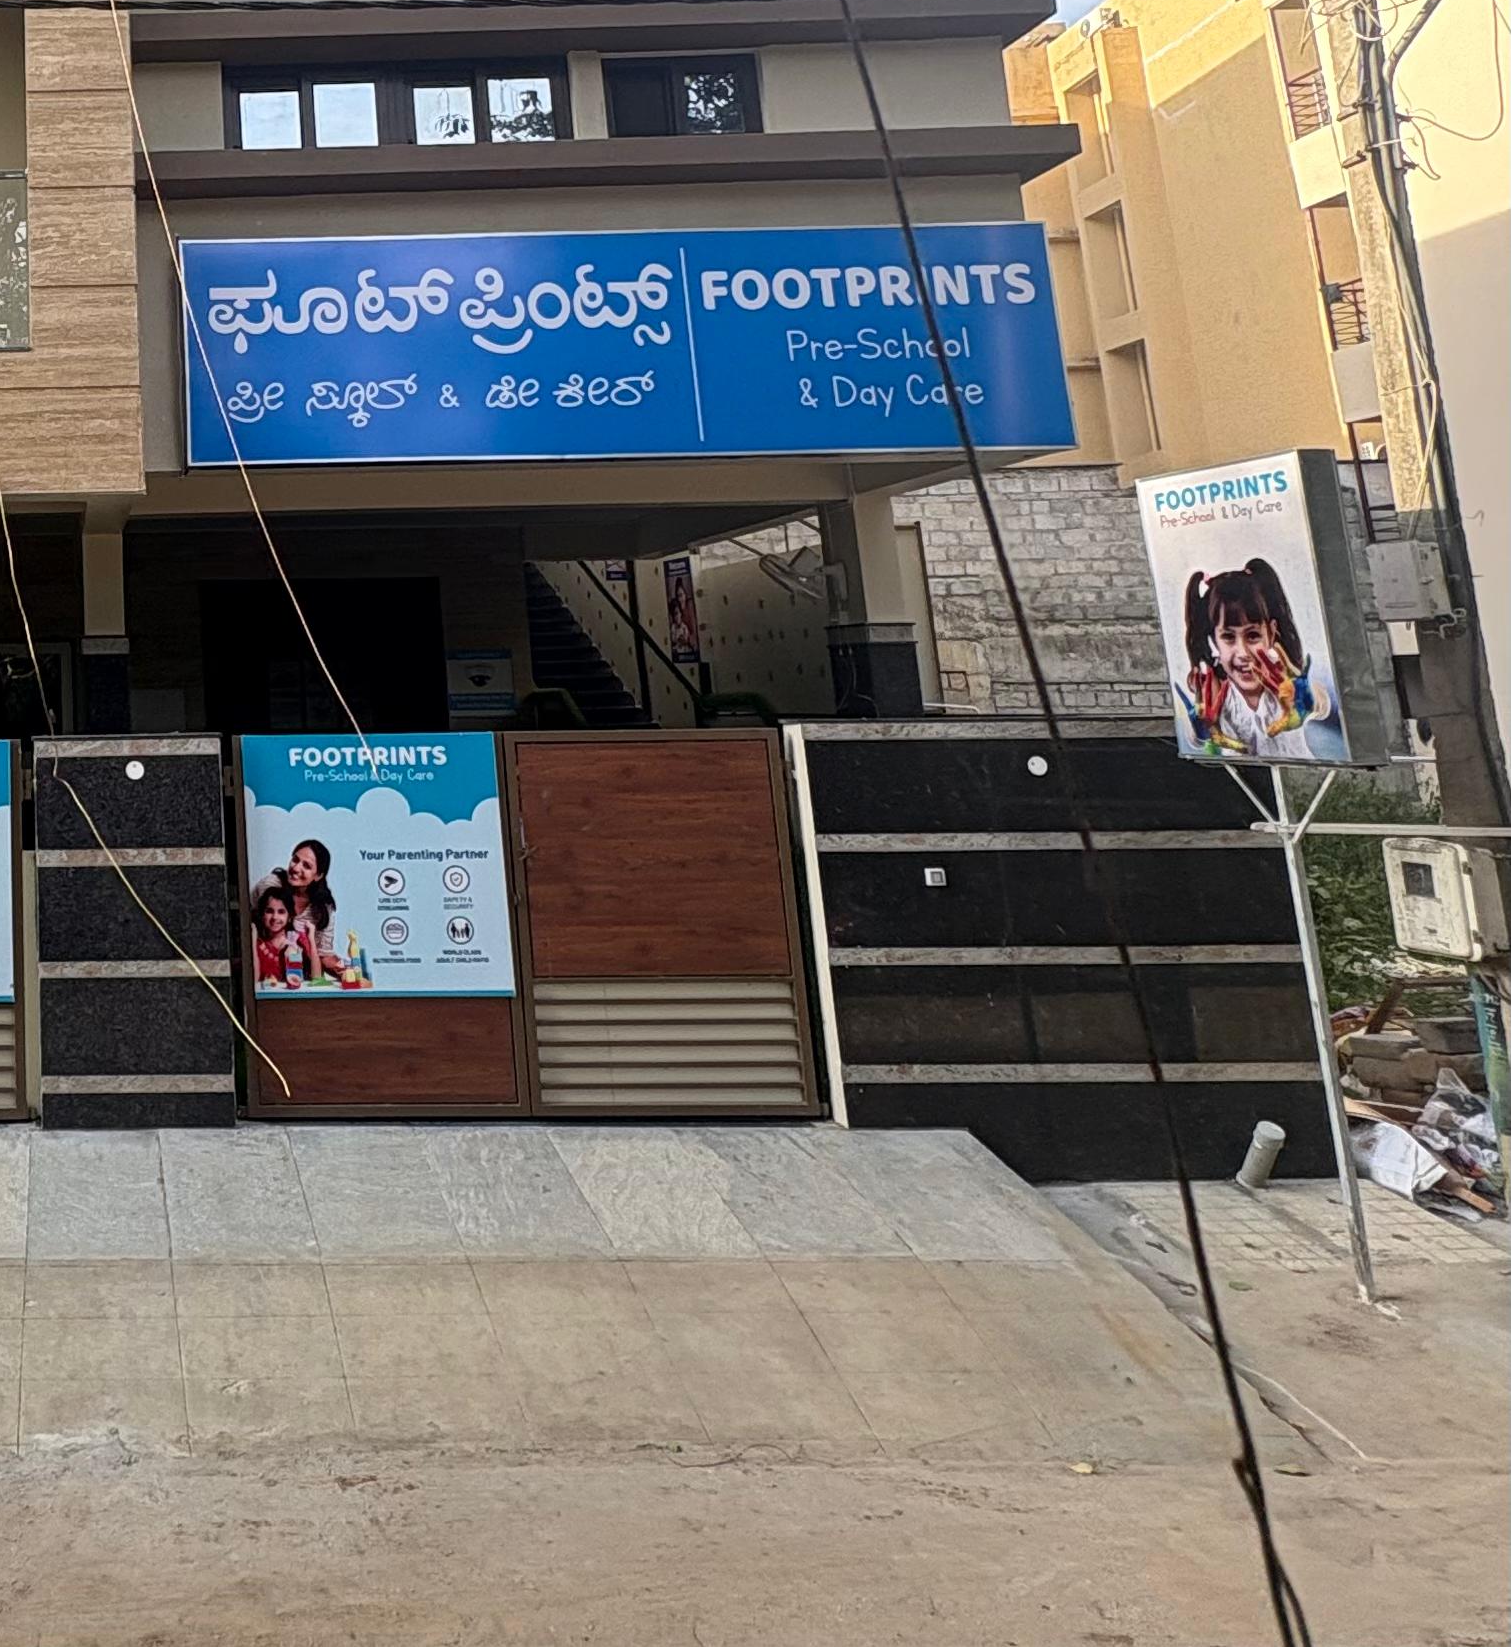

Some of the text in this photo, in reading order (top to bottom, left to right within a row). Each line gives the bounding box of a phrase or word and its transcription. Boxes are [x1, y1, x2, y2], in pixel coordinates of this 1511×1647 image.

[786, 326, 970, 362] Pre-School
[227, 370, 655, 428] ಪ್ರೀ ಸ್ಕೂಲ್ & ಡೇ ಕೇರ್
[798, 378, 818, 408] &
[832, 375, 894, 417] Day
[1154, 470, 1288, 512] FOOTPRINTS
[1160, 499, 1283, 529] Pre-School & Day Care
[288, 745, 447, 767] FOOTPRINTS
[304, 769, 368, 782] Pre-School
[381, 768, 403, 785] Day
[407, 768, 434, 781] Care
[359, 848, 489, 862] Your Parenting Partner
